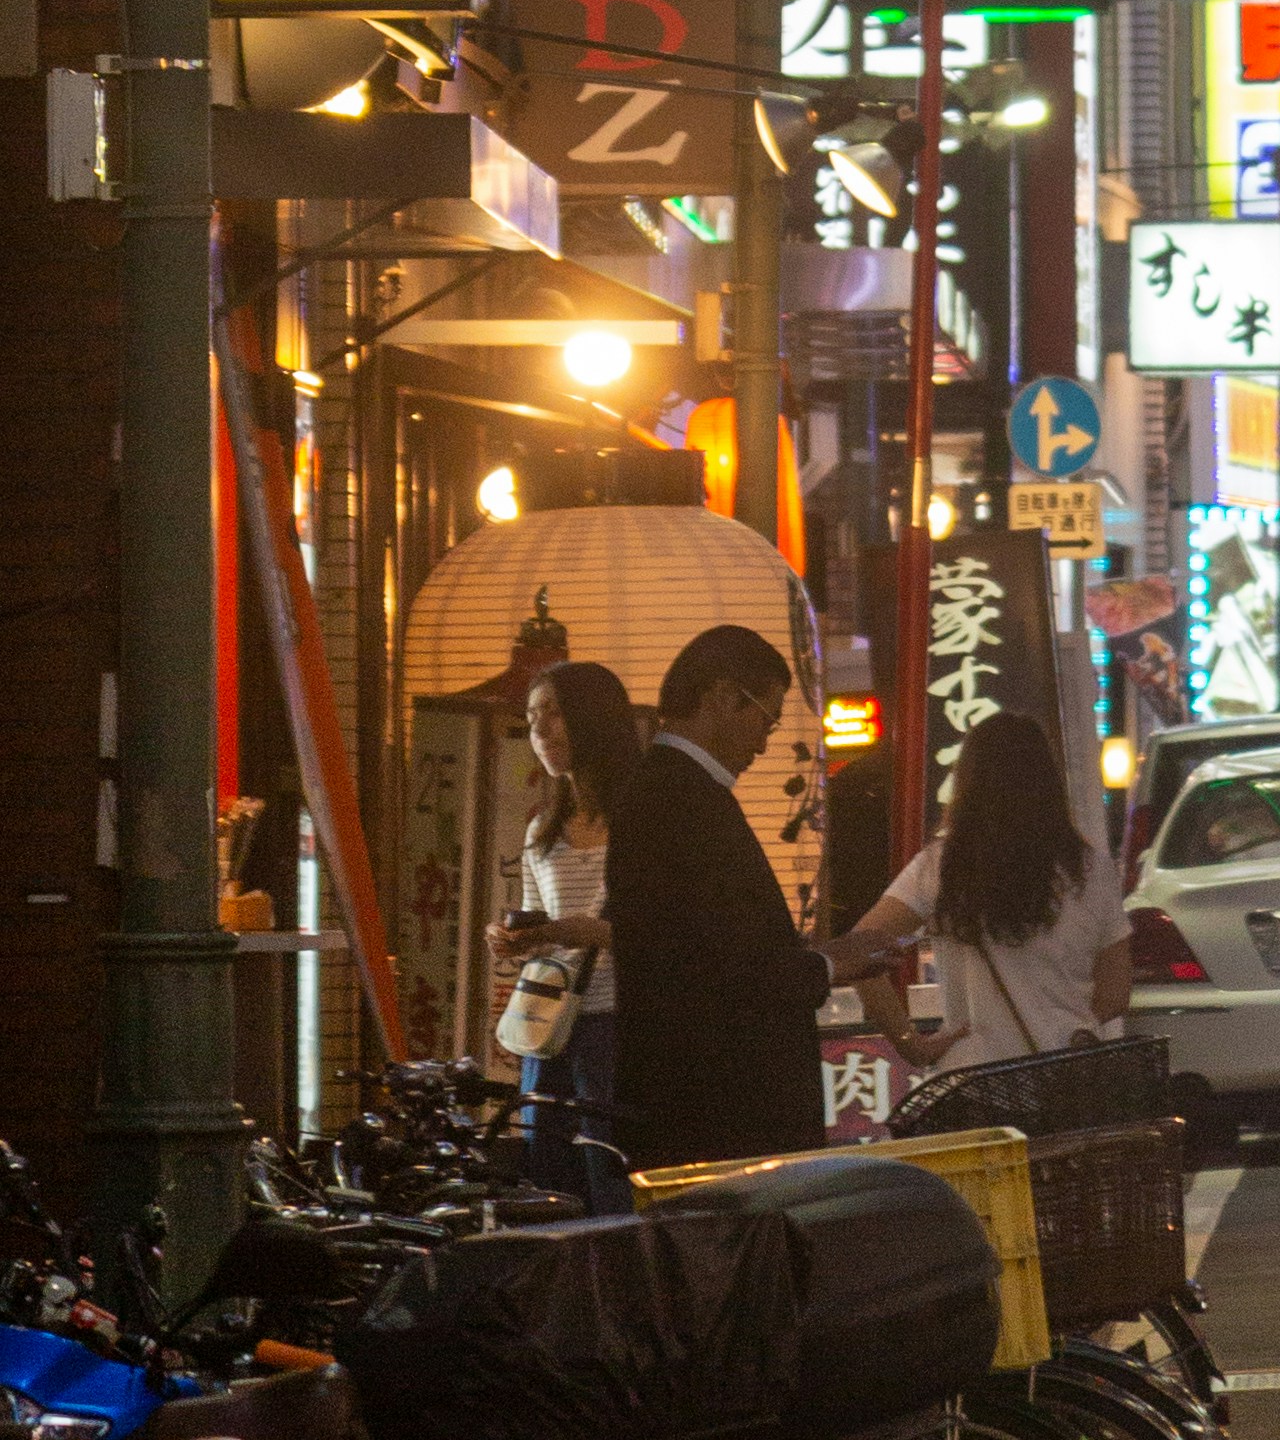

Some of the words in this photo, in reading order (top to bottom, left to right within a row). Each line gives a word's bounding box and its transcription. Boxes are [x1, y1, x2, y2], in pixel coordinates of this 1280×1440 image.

[1017, 513, 1096, 534] 一方通行
[822, 1054, 891, 1127] 肉
